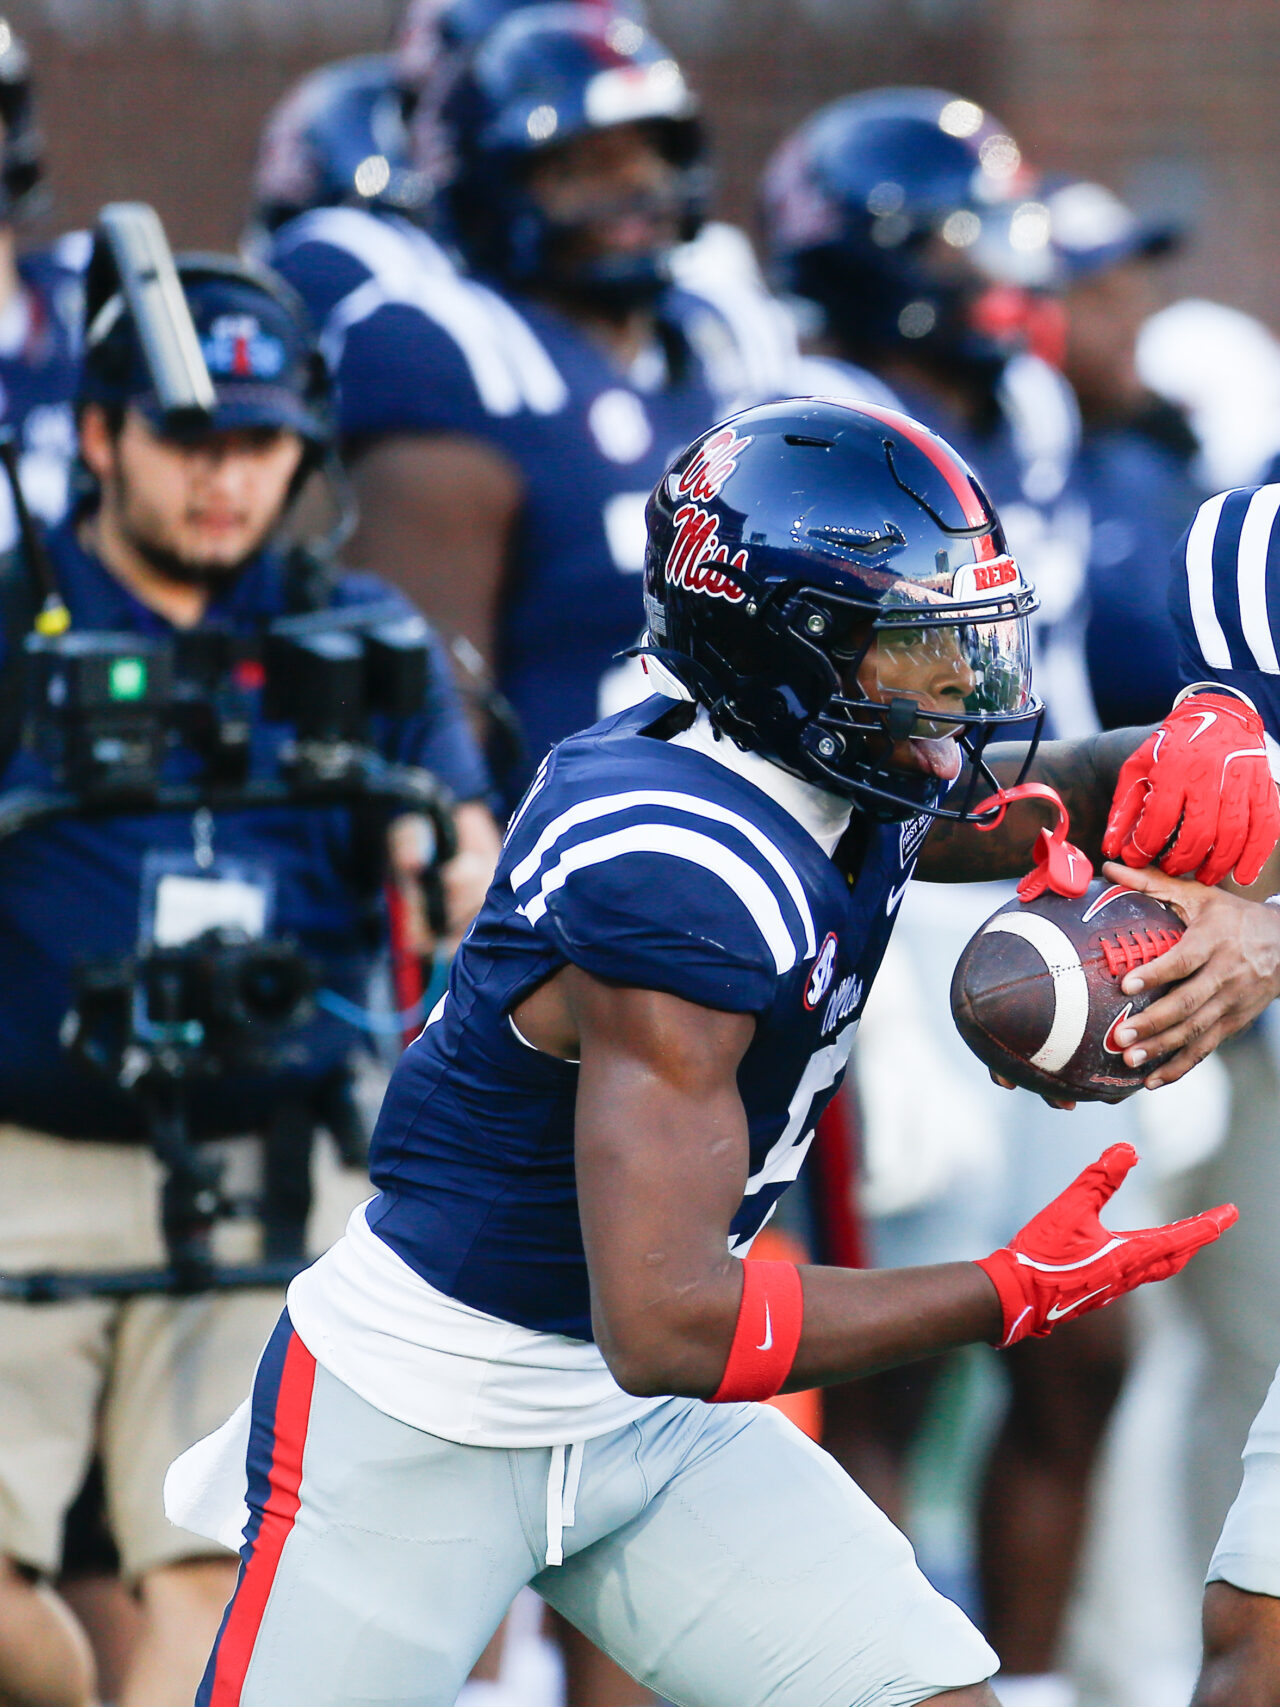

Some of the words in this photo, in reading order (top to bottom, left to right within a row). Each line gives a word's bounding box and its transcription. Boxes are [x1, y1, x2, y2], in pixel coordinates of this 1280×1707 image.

[676, 428, 755, 503] Ole
[665, 503, 749, 604] Miss
[973, 559, 1017, 591] REBS
